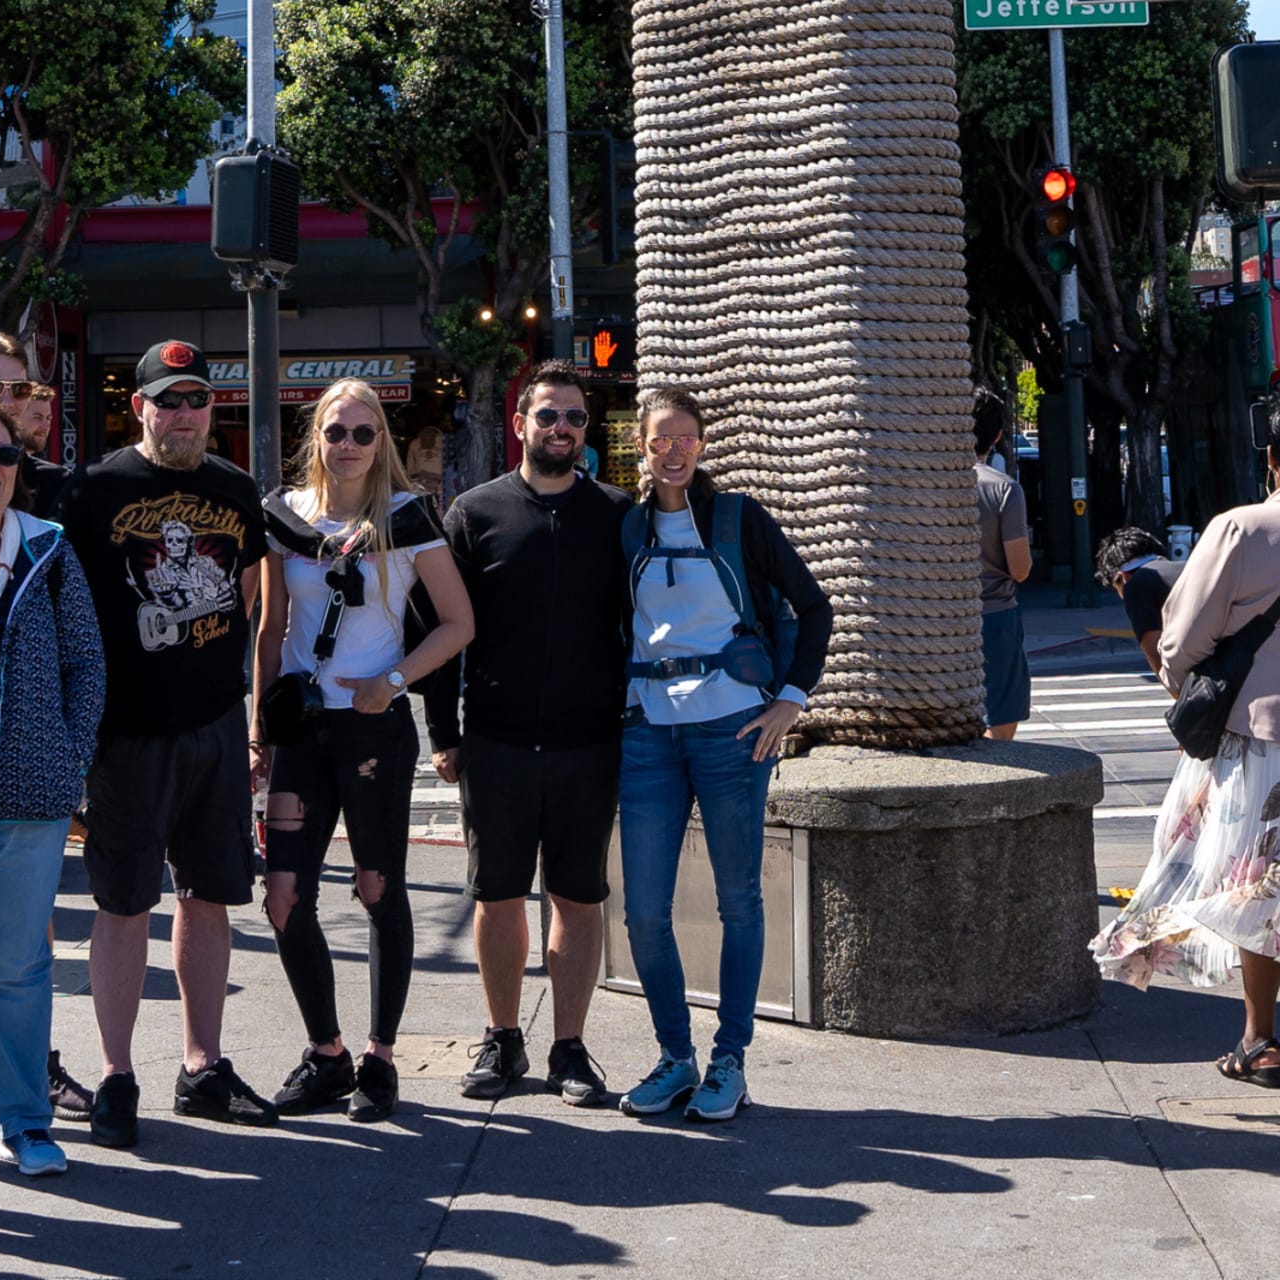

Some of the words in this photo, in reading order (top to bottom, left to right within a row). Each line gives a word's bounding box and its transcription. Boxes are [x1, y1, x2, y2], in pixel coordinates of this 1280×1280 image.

[287, 360, 394, 379] CENTRAL
[110, 491, 246, 550] Rockabilly
[193, 613, 219, 636] Old
[193, 620, 230, 648] School
